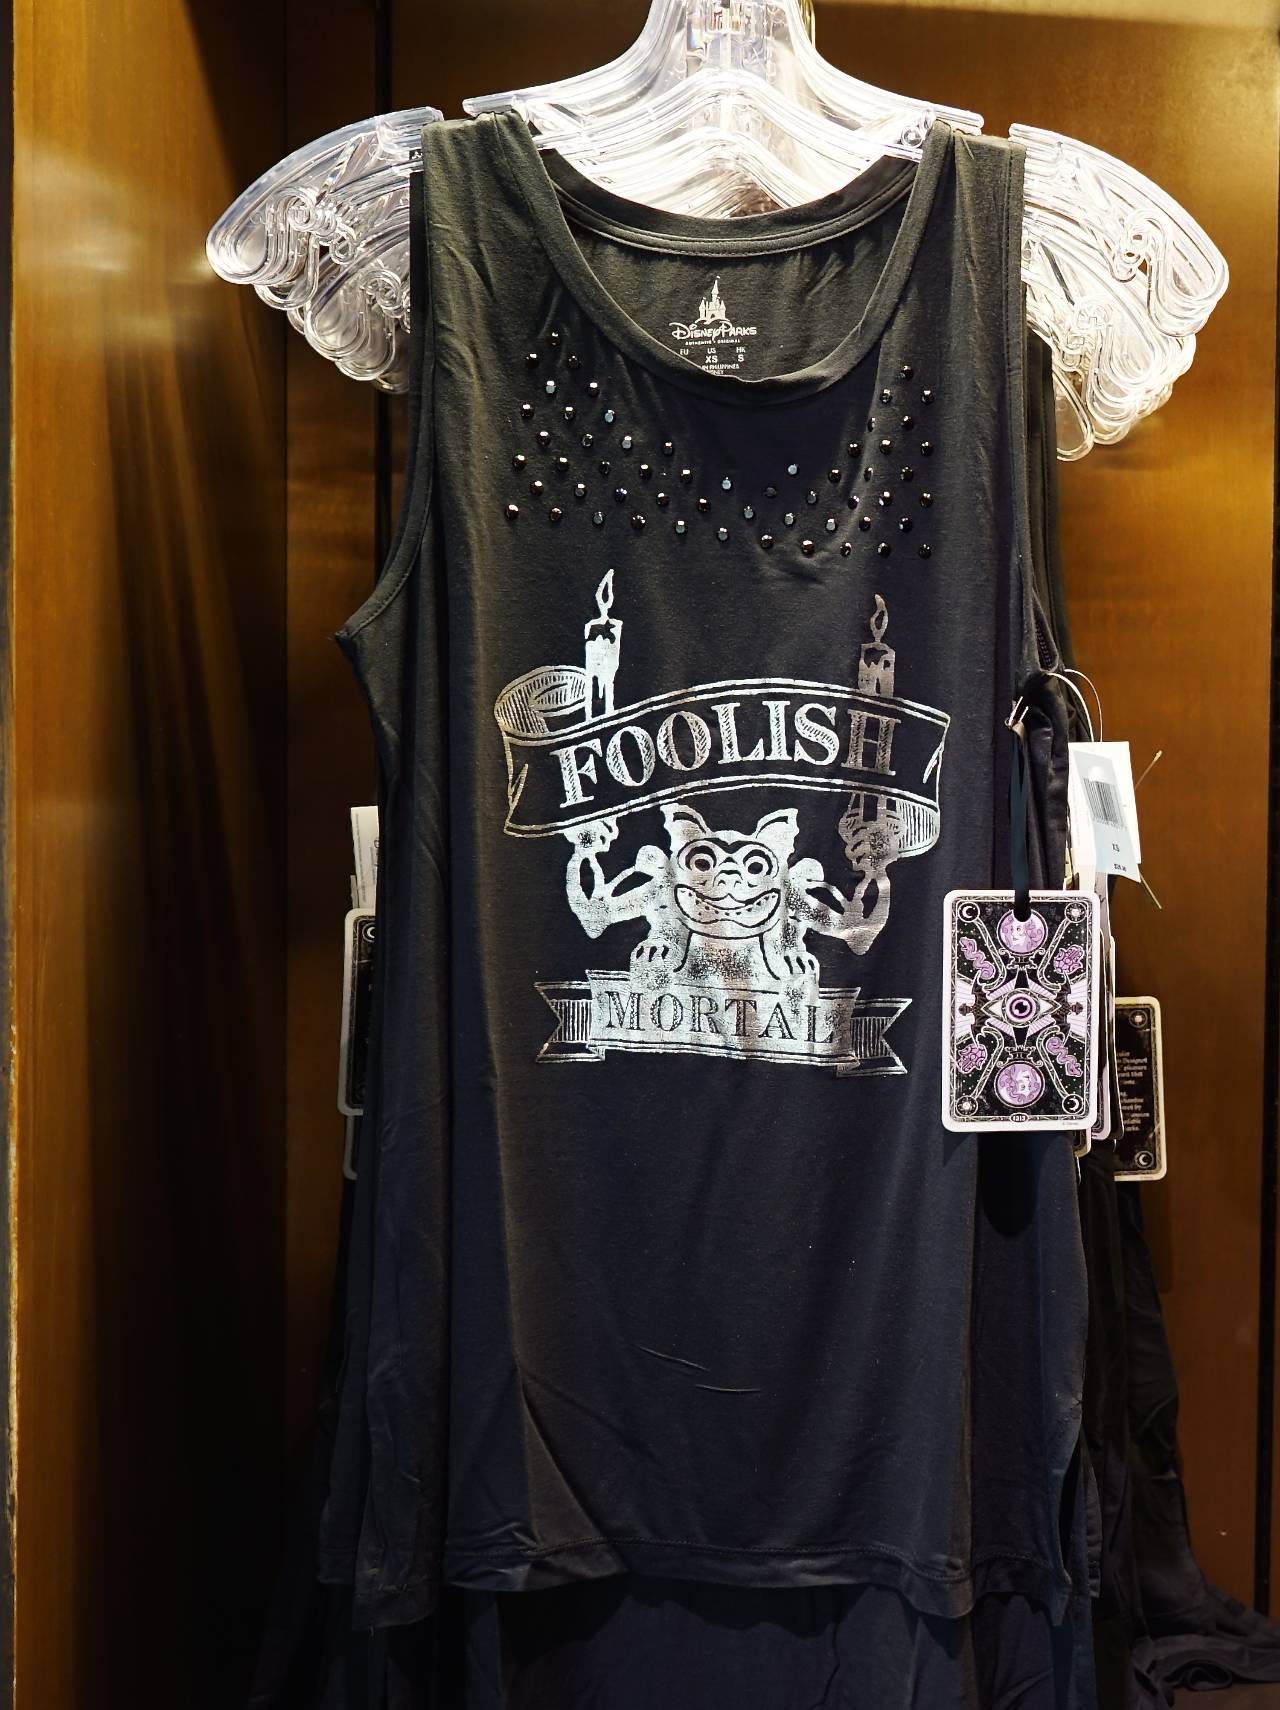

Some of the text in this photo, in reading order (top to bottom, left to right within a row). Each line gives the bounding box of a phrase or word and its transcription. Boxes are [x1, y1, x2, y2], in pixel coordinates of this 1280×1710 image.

[705, 354, 745, 363] XS S
[549, 700, 901, 809] FOOLISH
[605, 991, 835, 1043] MORTAL
